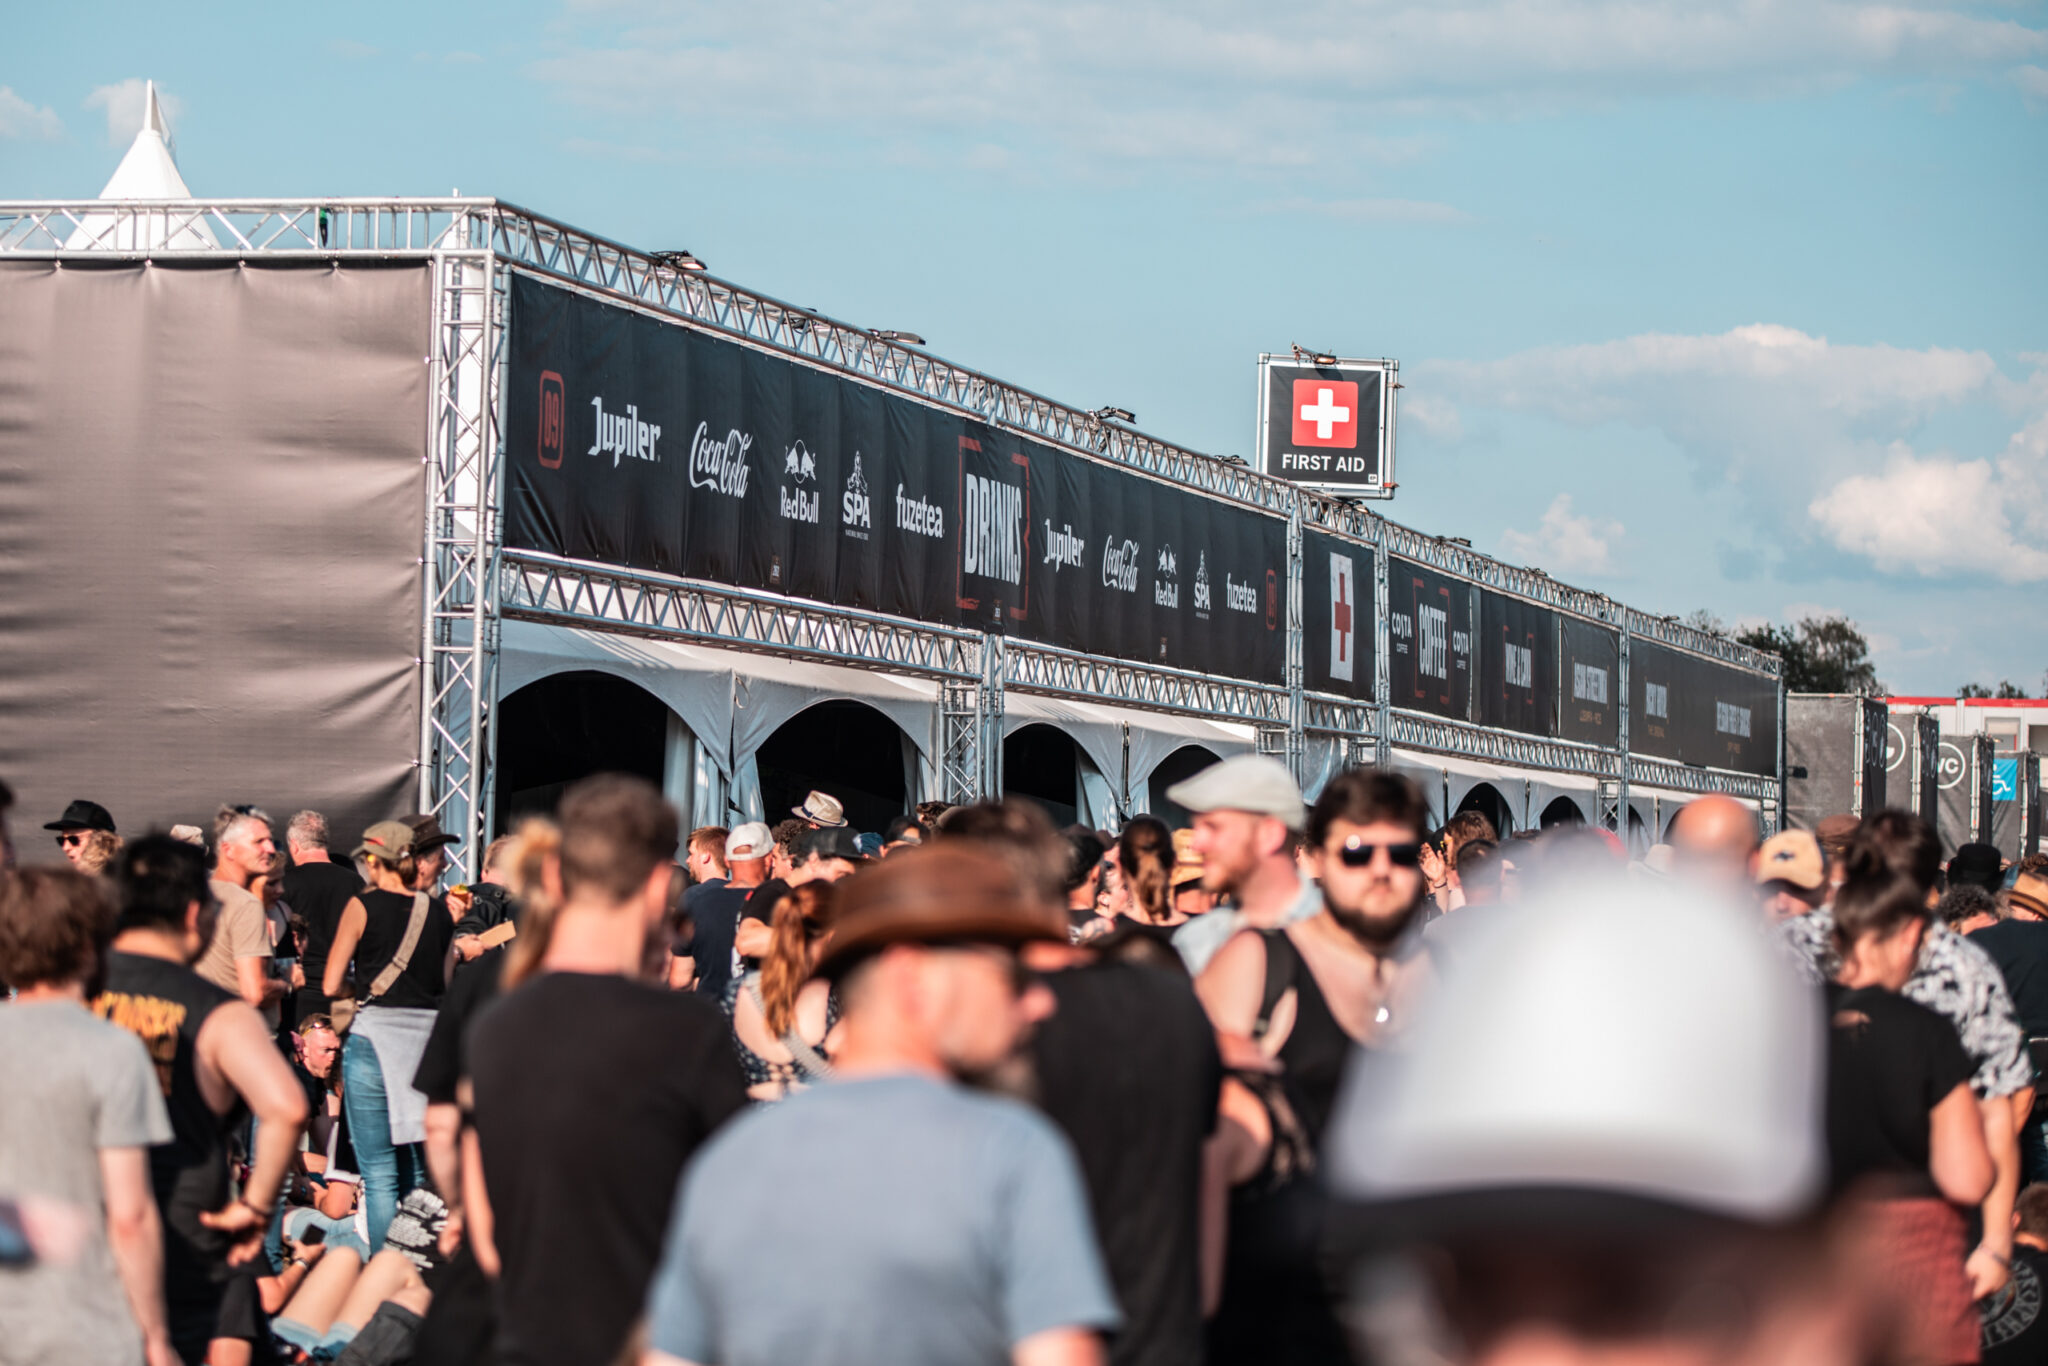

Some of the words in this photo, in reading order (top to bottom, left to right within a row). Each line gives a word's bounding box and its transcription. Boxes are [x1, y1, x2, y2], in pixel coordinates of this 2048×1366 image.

[587, 396, 661, 468] Jupiler
[689, 420, 753, 499] Coca-Cola
[1282, 453, 1331, 471] FIRST
[1335, 456, 1365, 472] AID
[843, 491, 871, 529] SPA
[896, 483, 943, 538] fuzetea
[965, 473, 1022, 586] DRINKS
[1043, 518, 1084, 573] Jupiler
[1102, 534, 1139, 593] Coca-Cola
[1194, 582, 1211, 611] SPA
[1226, 572, 1257, 614] fuzetea
[1391, 611, 1412, 640] COSTA
[1419, 602, 1447, 680] COFFEE
[1452, 630, 1469, 656] COSTA
